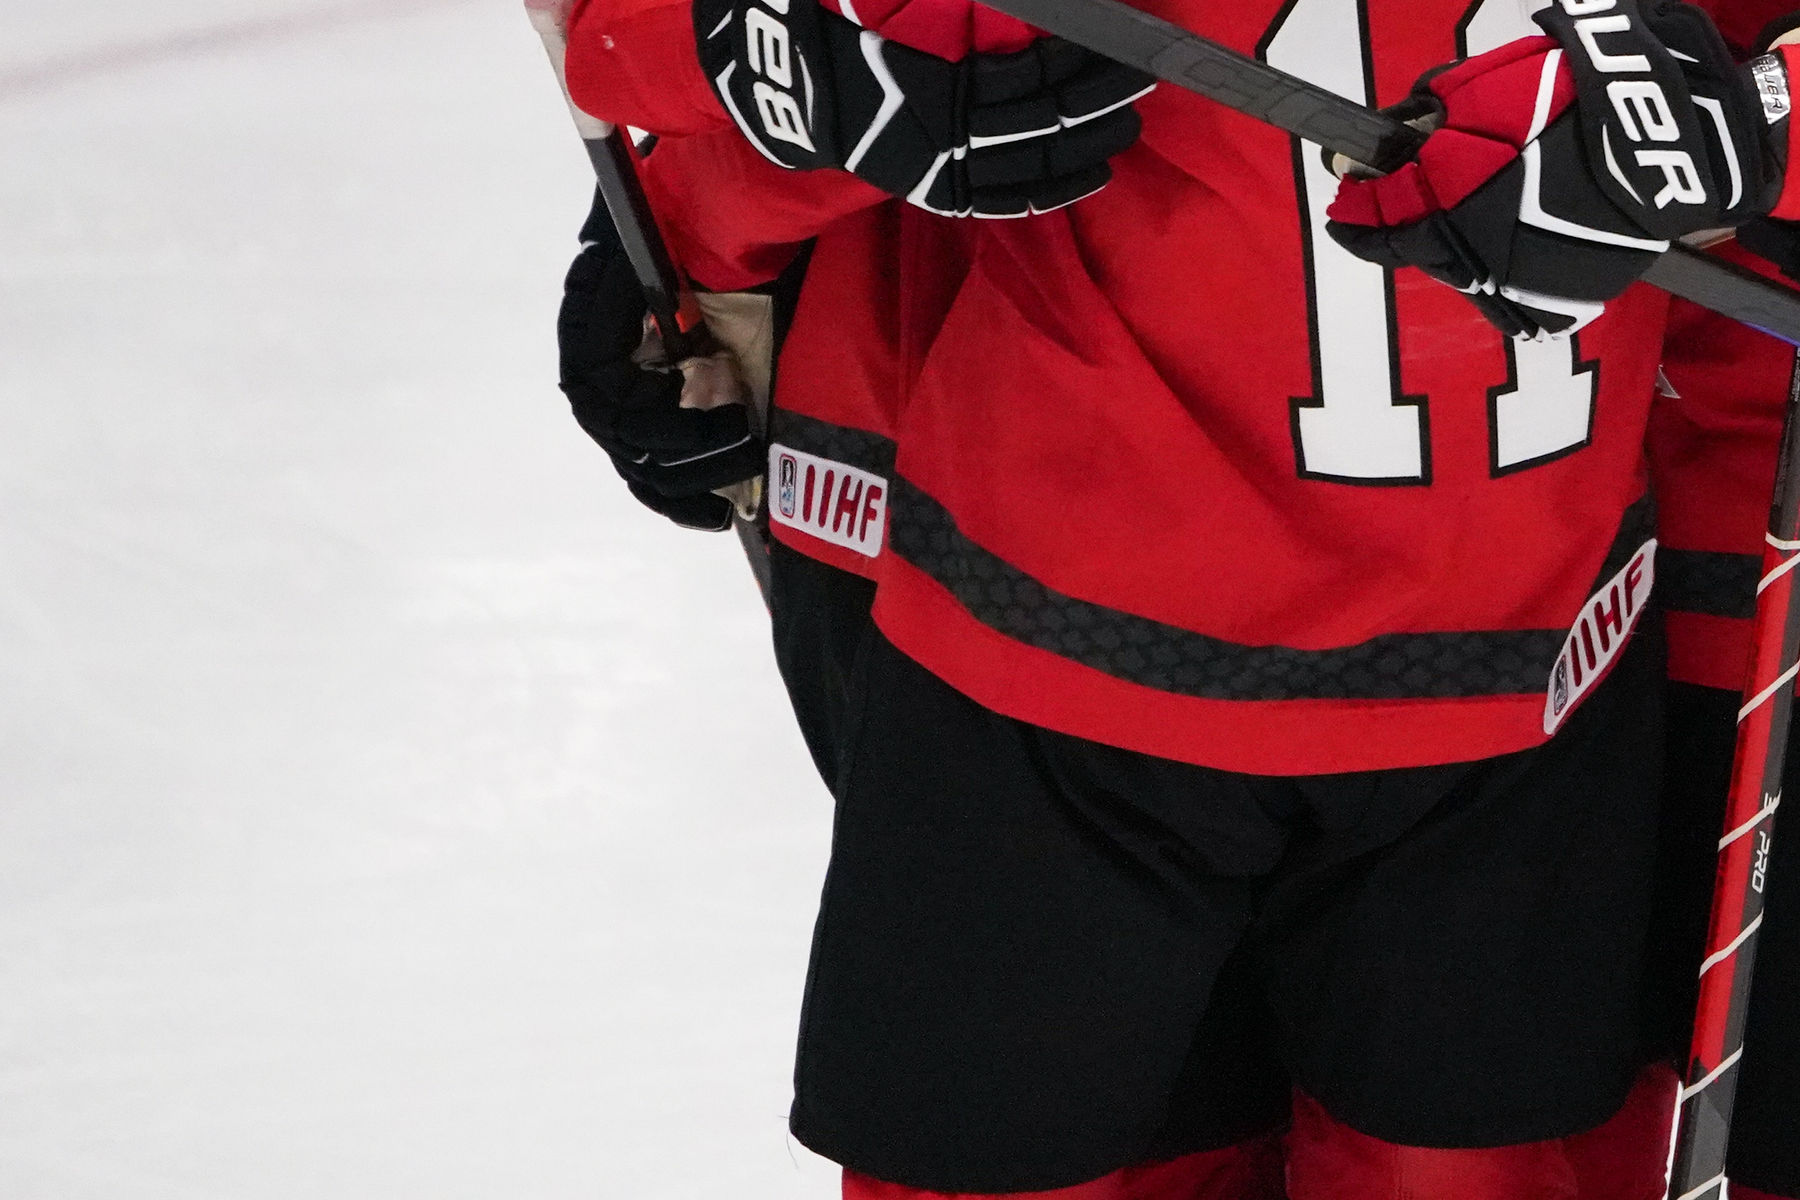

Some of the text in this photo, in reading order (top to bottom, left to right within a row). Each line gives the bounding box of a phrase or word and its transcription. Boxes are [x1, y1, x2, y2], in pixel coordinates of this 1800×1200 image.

[802, 464, 883, 543] IIHF
[1571, 553, 1645, 688] IIHF
[1751, 830, 1771, 895] PRO
